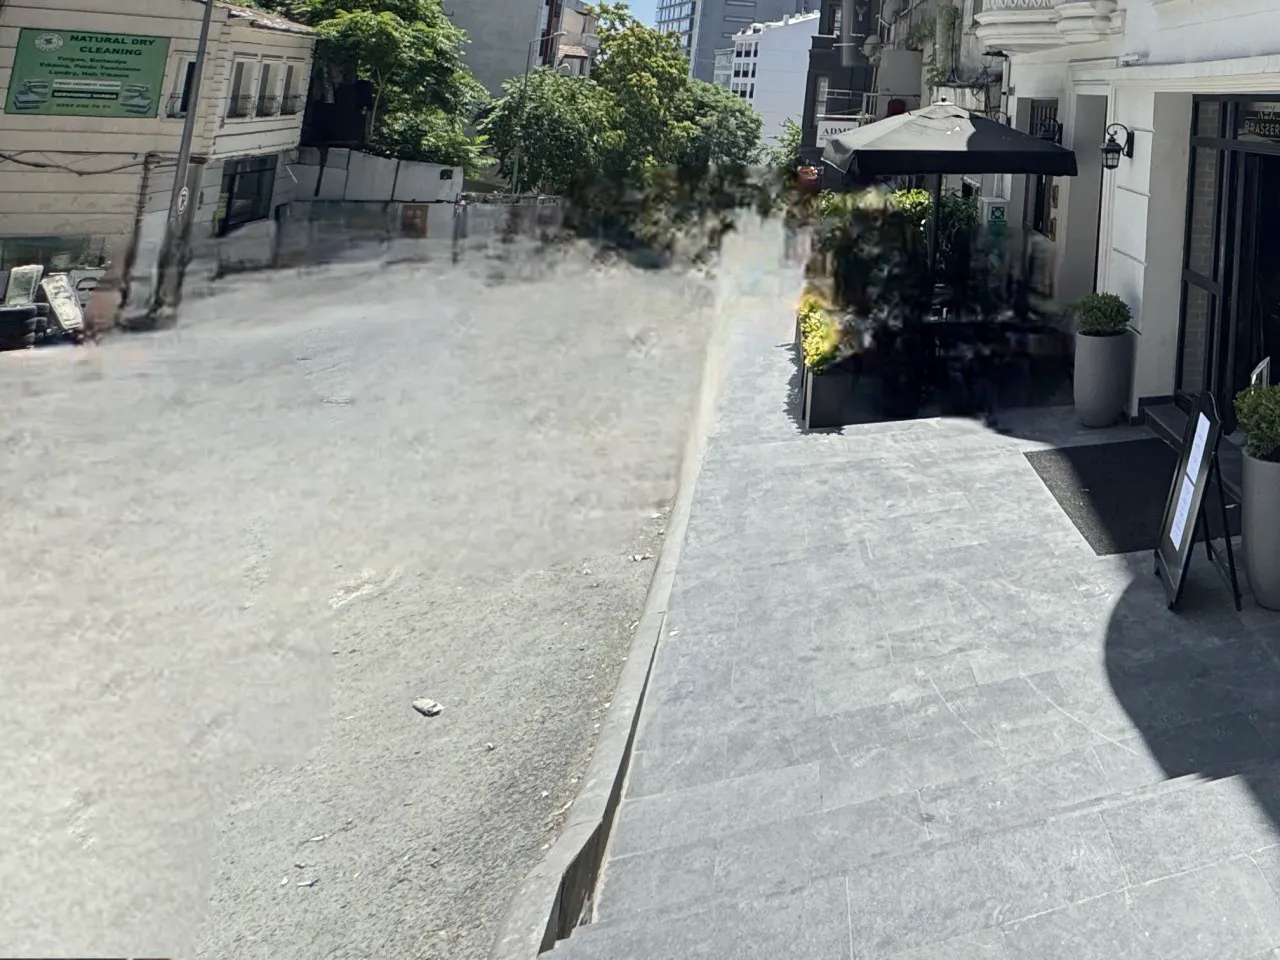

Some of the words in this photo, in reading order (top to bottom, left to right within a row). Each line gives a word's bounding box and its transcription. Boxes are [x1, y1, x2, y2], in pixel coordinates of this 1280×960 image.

[69, 34, 128, 45] NATURAL
[130, 38, 157, 47] DRY
[79, 46, 143, 56] CLEANING
[823, 127, 854, 135] ADM
